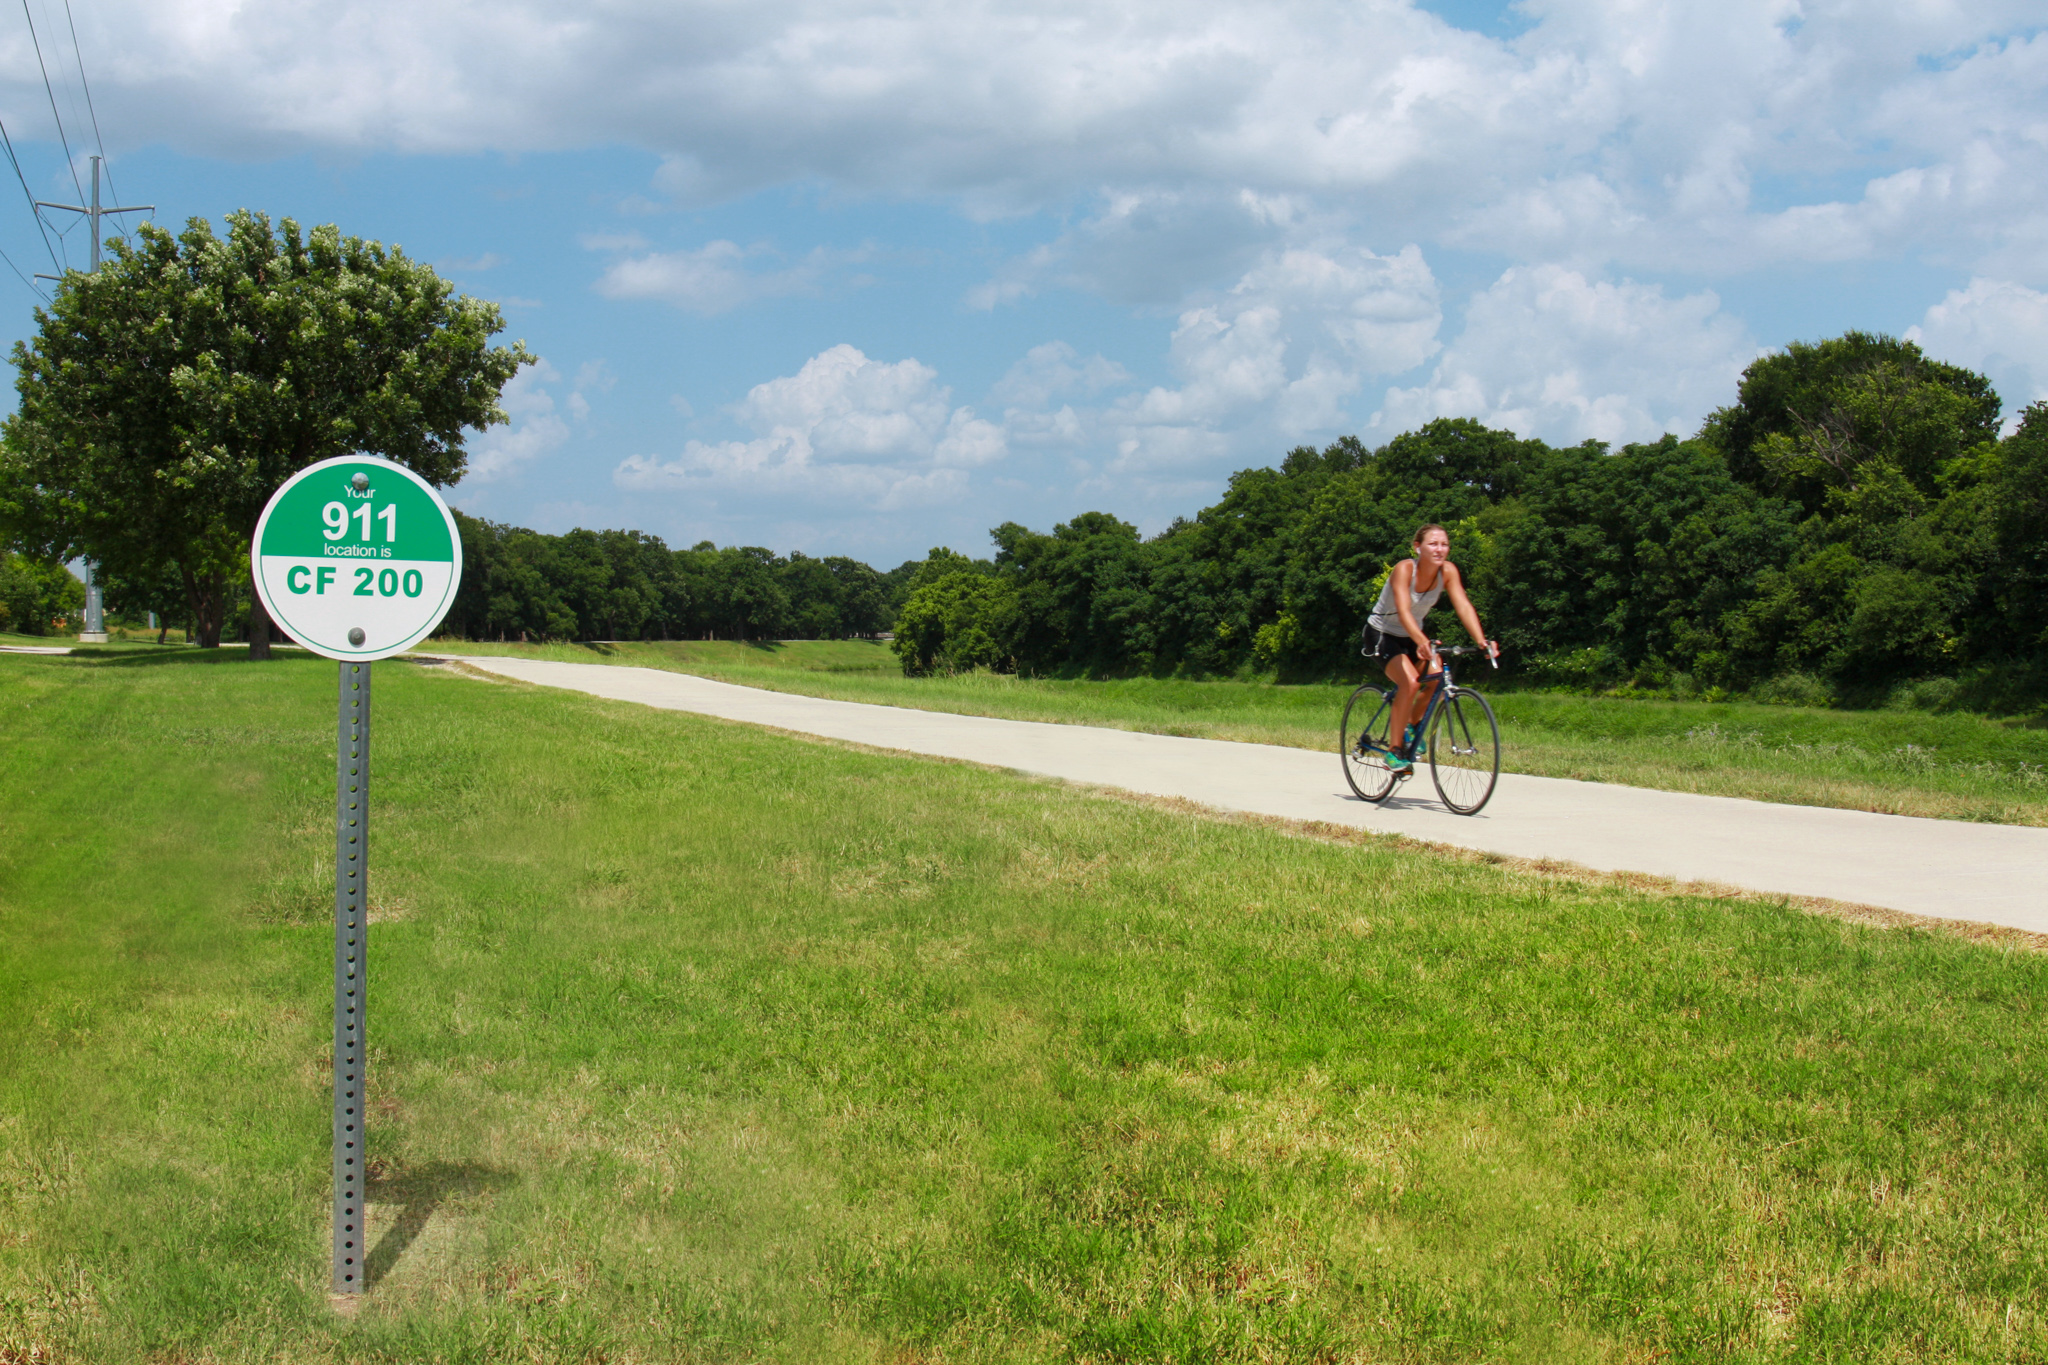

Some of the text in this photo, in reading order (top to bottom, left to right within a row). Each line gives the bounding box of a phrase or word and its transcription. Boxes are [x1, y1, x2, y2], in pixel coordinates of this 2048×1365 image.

[343, 484, 376, 499] Your
[322, 501, 397, 542] 911
[324, 543, 392, 558] location is
[286, 565, 423, 598] CF 200
